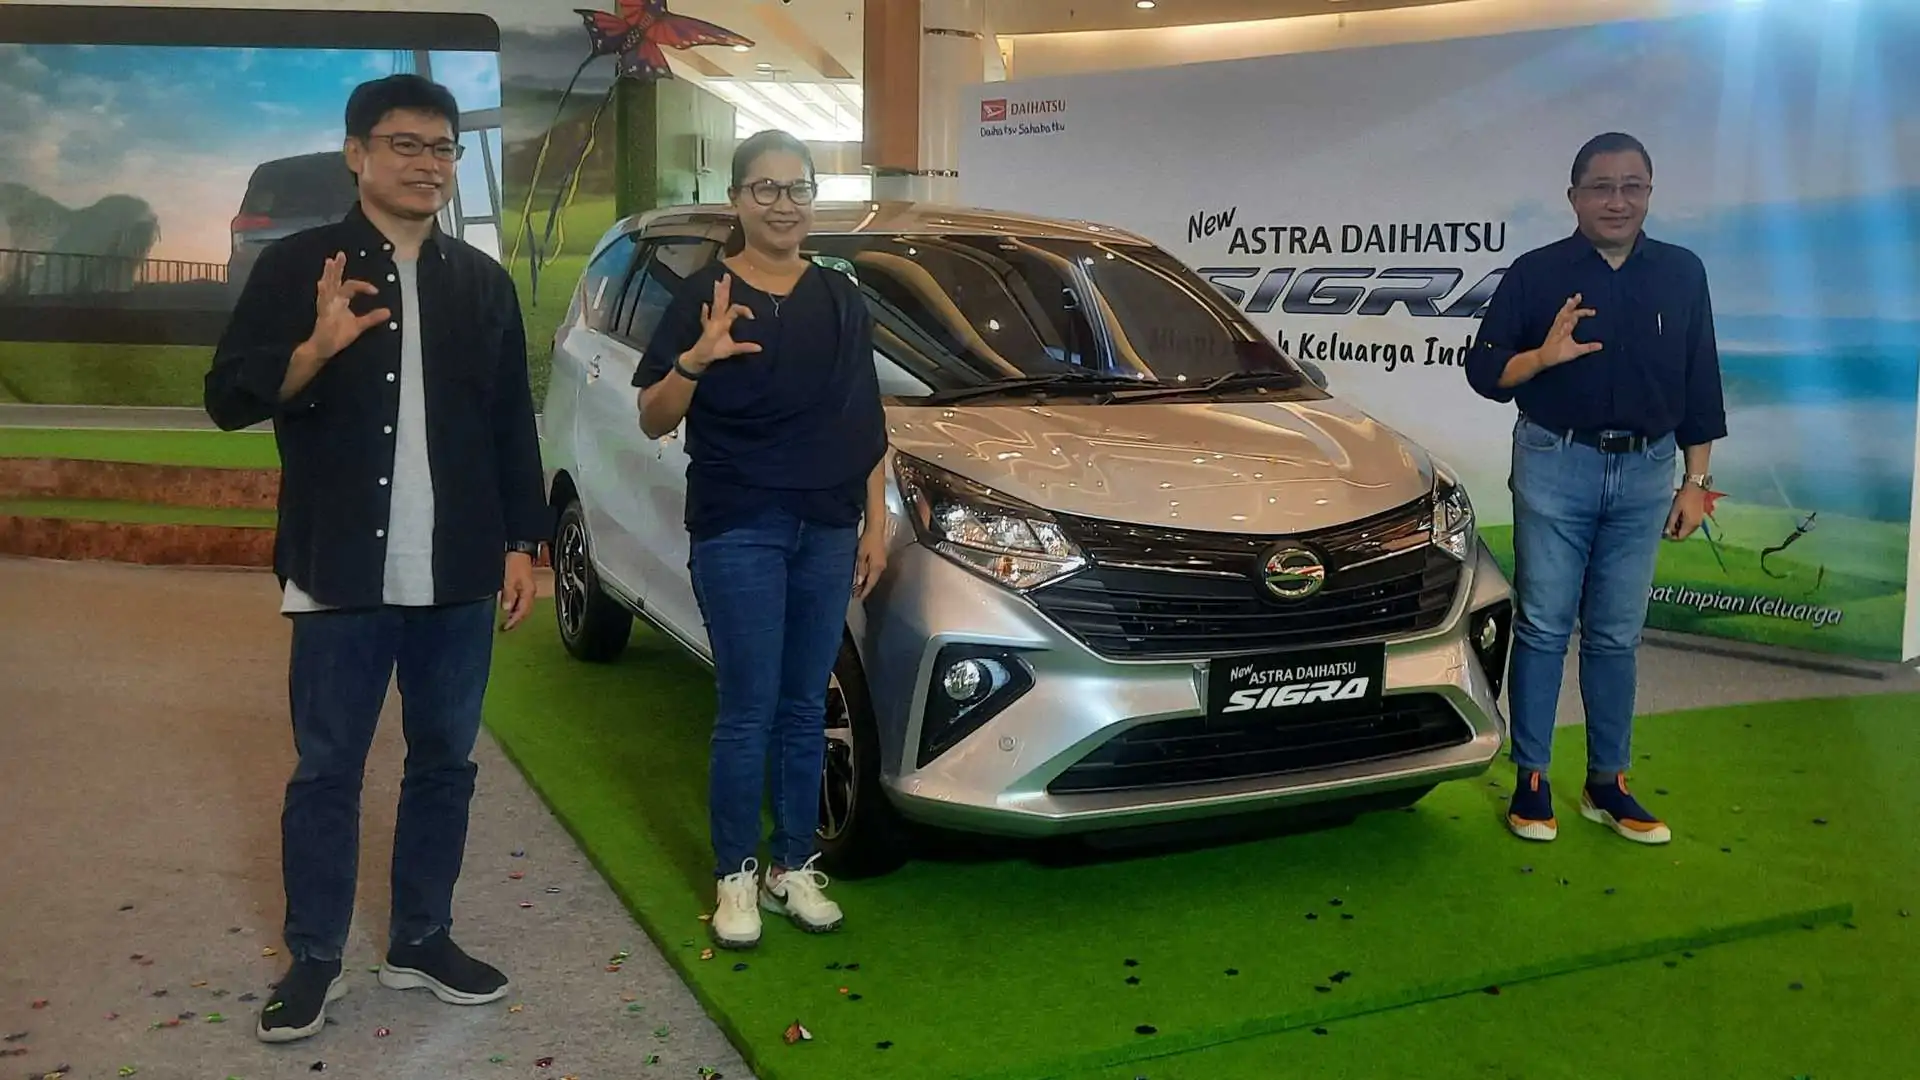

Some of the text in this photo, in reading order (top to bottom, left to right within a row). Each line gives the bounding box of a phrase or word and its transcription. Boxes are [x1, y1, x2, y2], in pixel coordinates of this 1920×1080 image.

[1010, 99, 1067, 116] DAIHATSU
[980, 125, 1017, 138] Daihatsu
[1187, 205, 1238, 244] New
[1227, 221, 1507, 255] ASTRA DAIHATSU
[1298, 331, 1416, 373] Keluarga
[1676, 585, 1745, 612] Impian
[1748, 594, 1844, 628] Keluarga
[1248, 660, 1357, 686] ASTRA DAIHATSU
[1221, 676, 1370, 714] SIGRA
